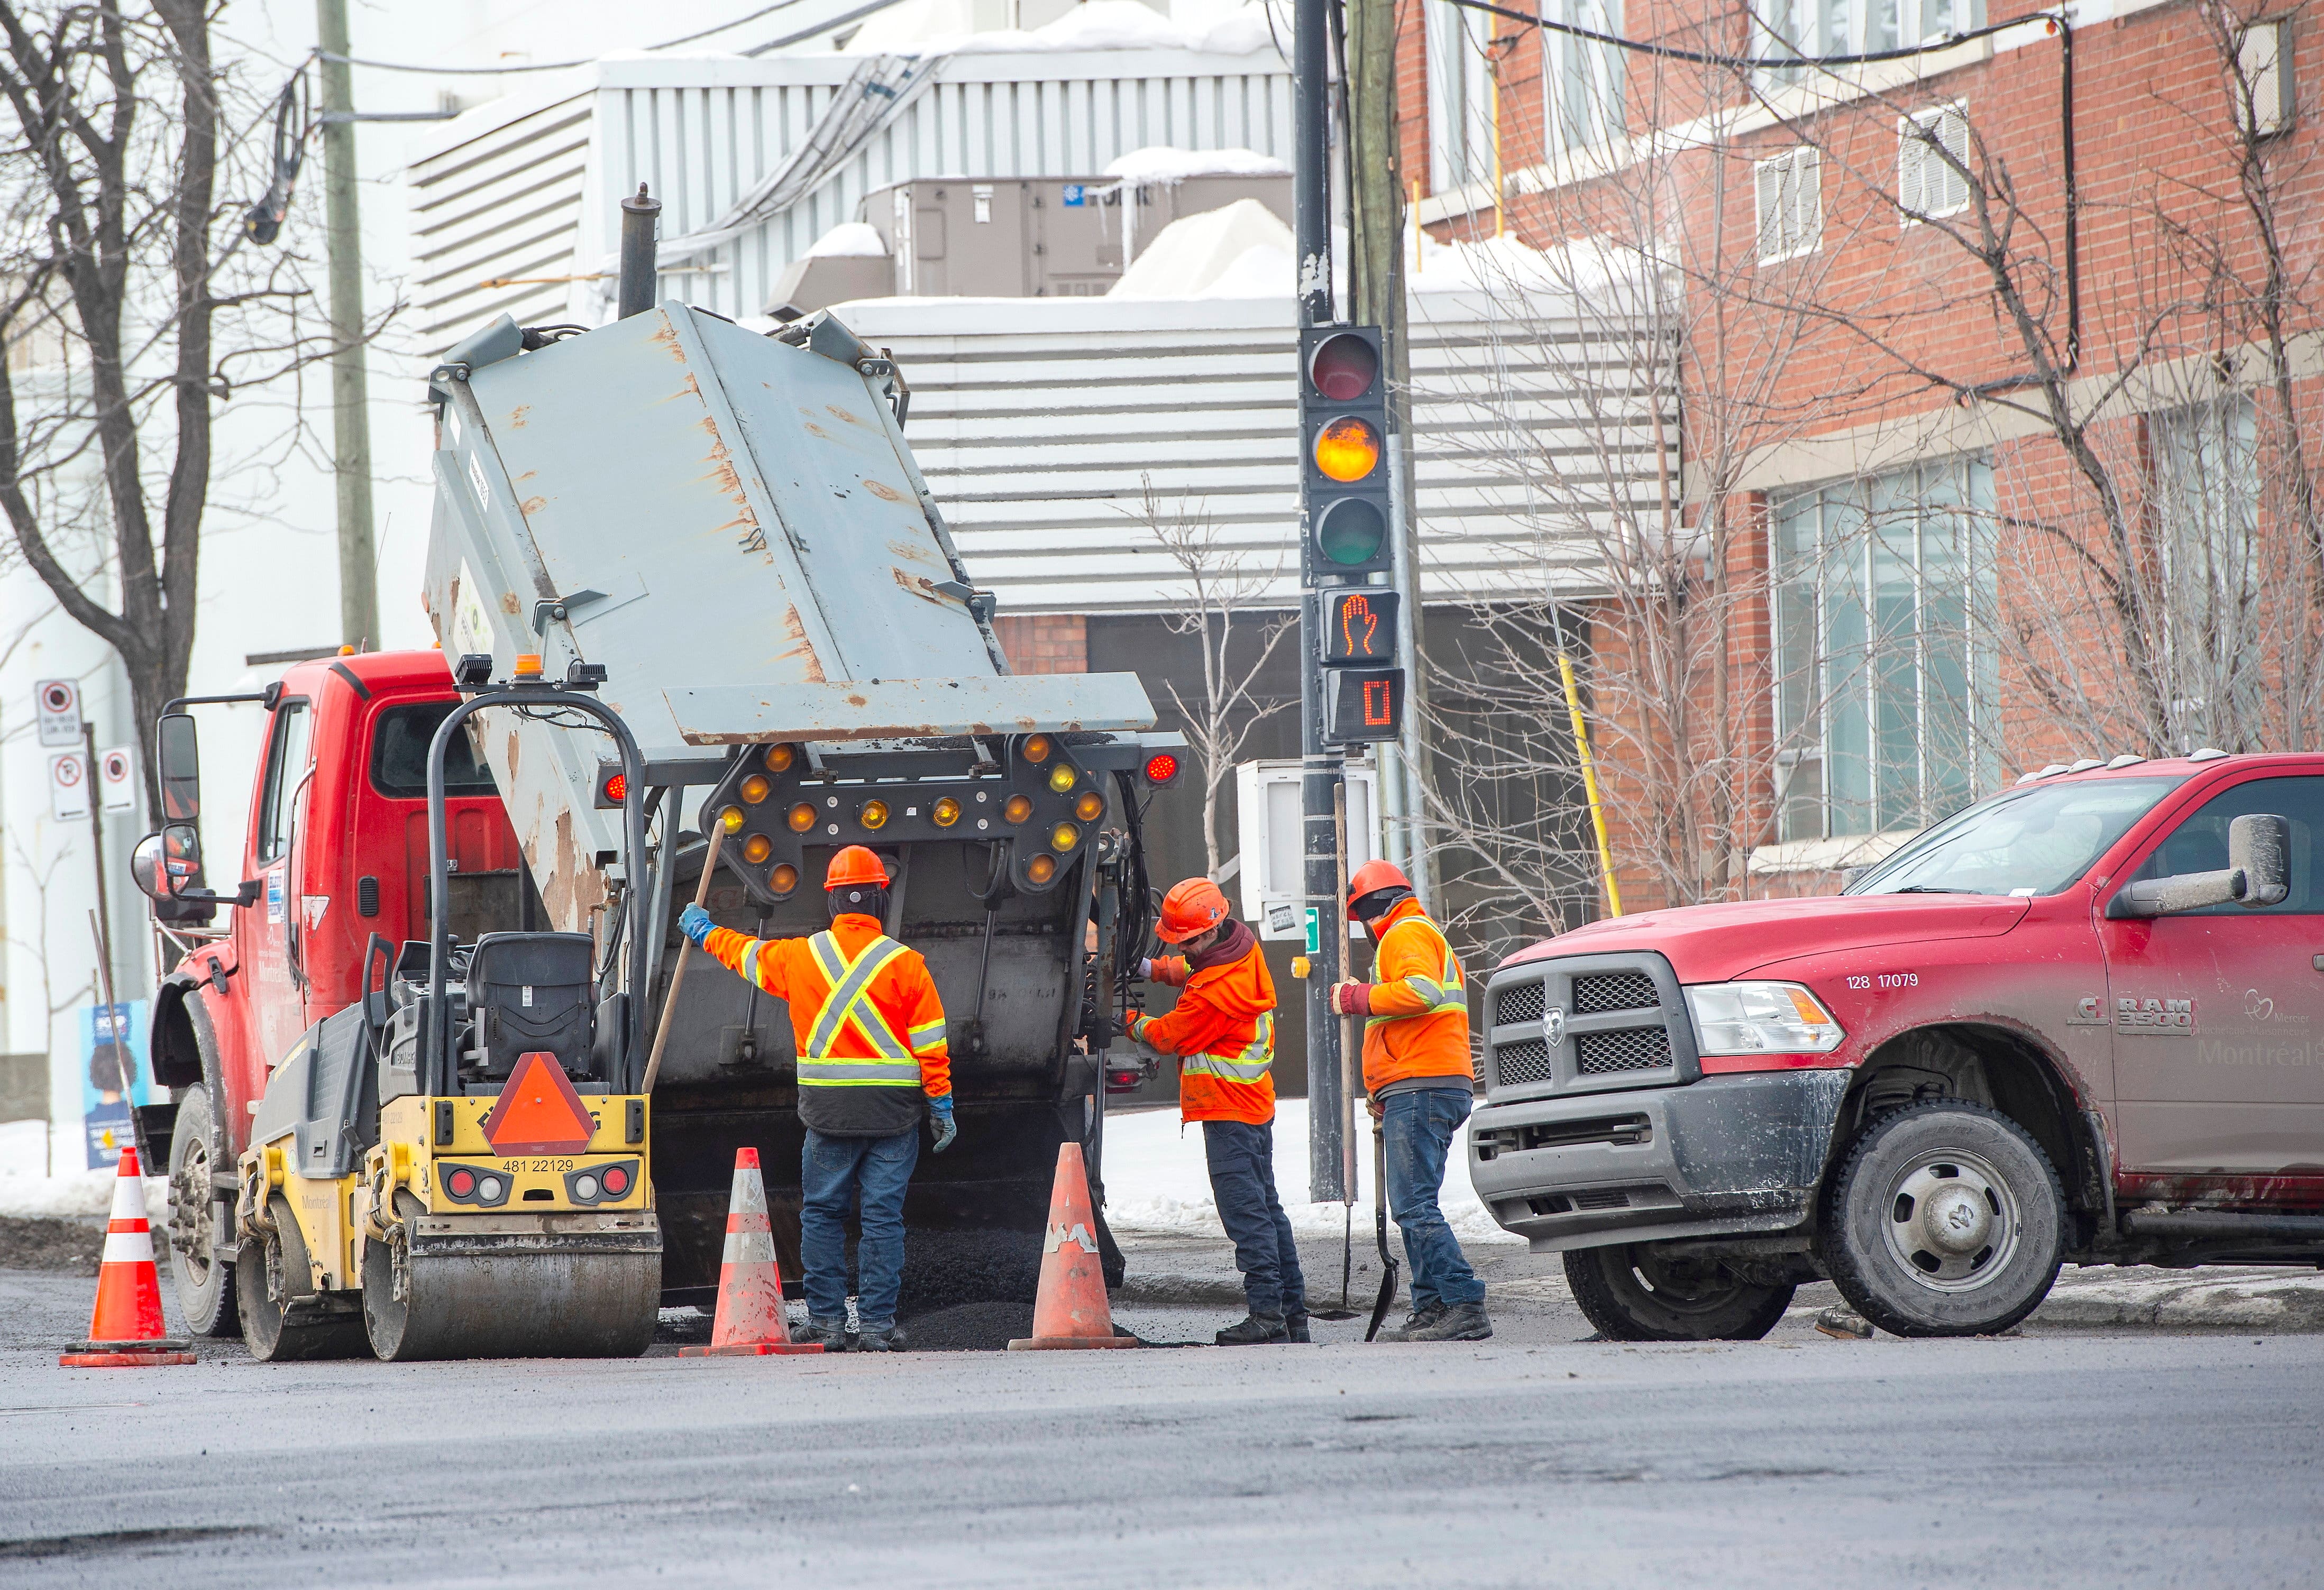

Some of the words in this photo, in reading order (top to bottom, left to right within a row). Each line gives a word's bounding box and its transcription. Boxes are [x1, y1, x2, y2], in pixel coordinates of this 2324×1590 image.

[1364, 680, 1390, 726] 0
[1846, 976, 1870, 989] 128
[1878, 973, 1918, 988] 17079
[2118, 998, 2192, 1013] RAM
[2118, 1012, 2192, 1027] 3500
[2274, 1012, 2310, 1023] Mercier
[2197, 1040, 2311, 1067] Montréal
[503, 1161, 526, 1172] 481
[532, 1160, 573, 1172] 22129
[301, 1195, 331, 1209] Montréa
